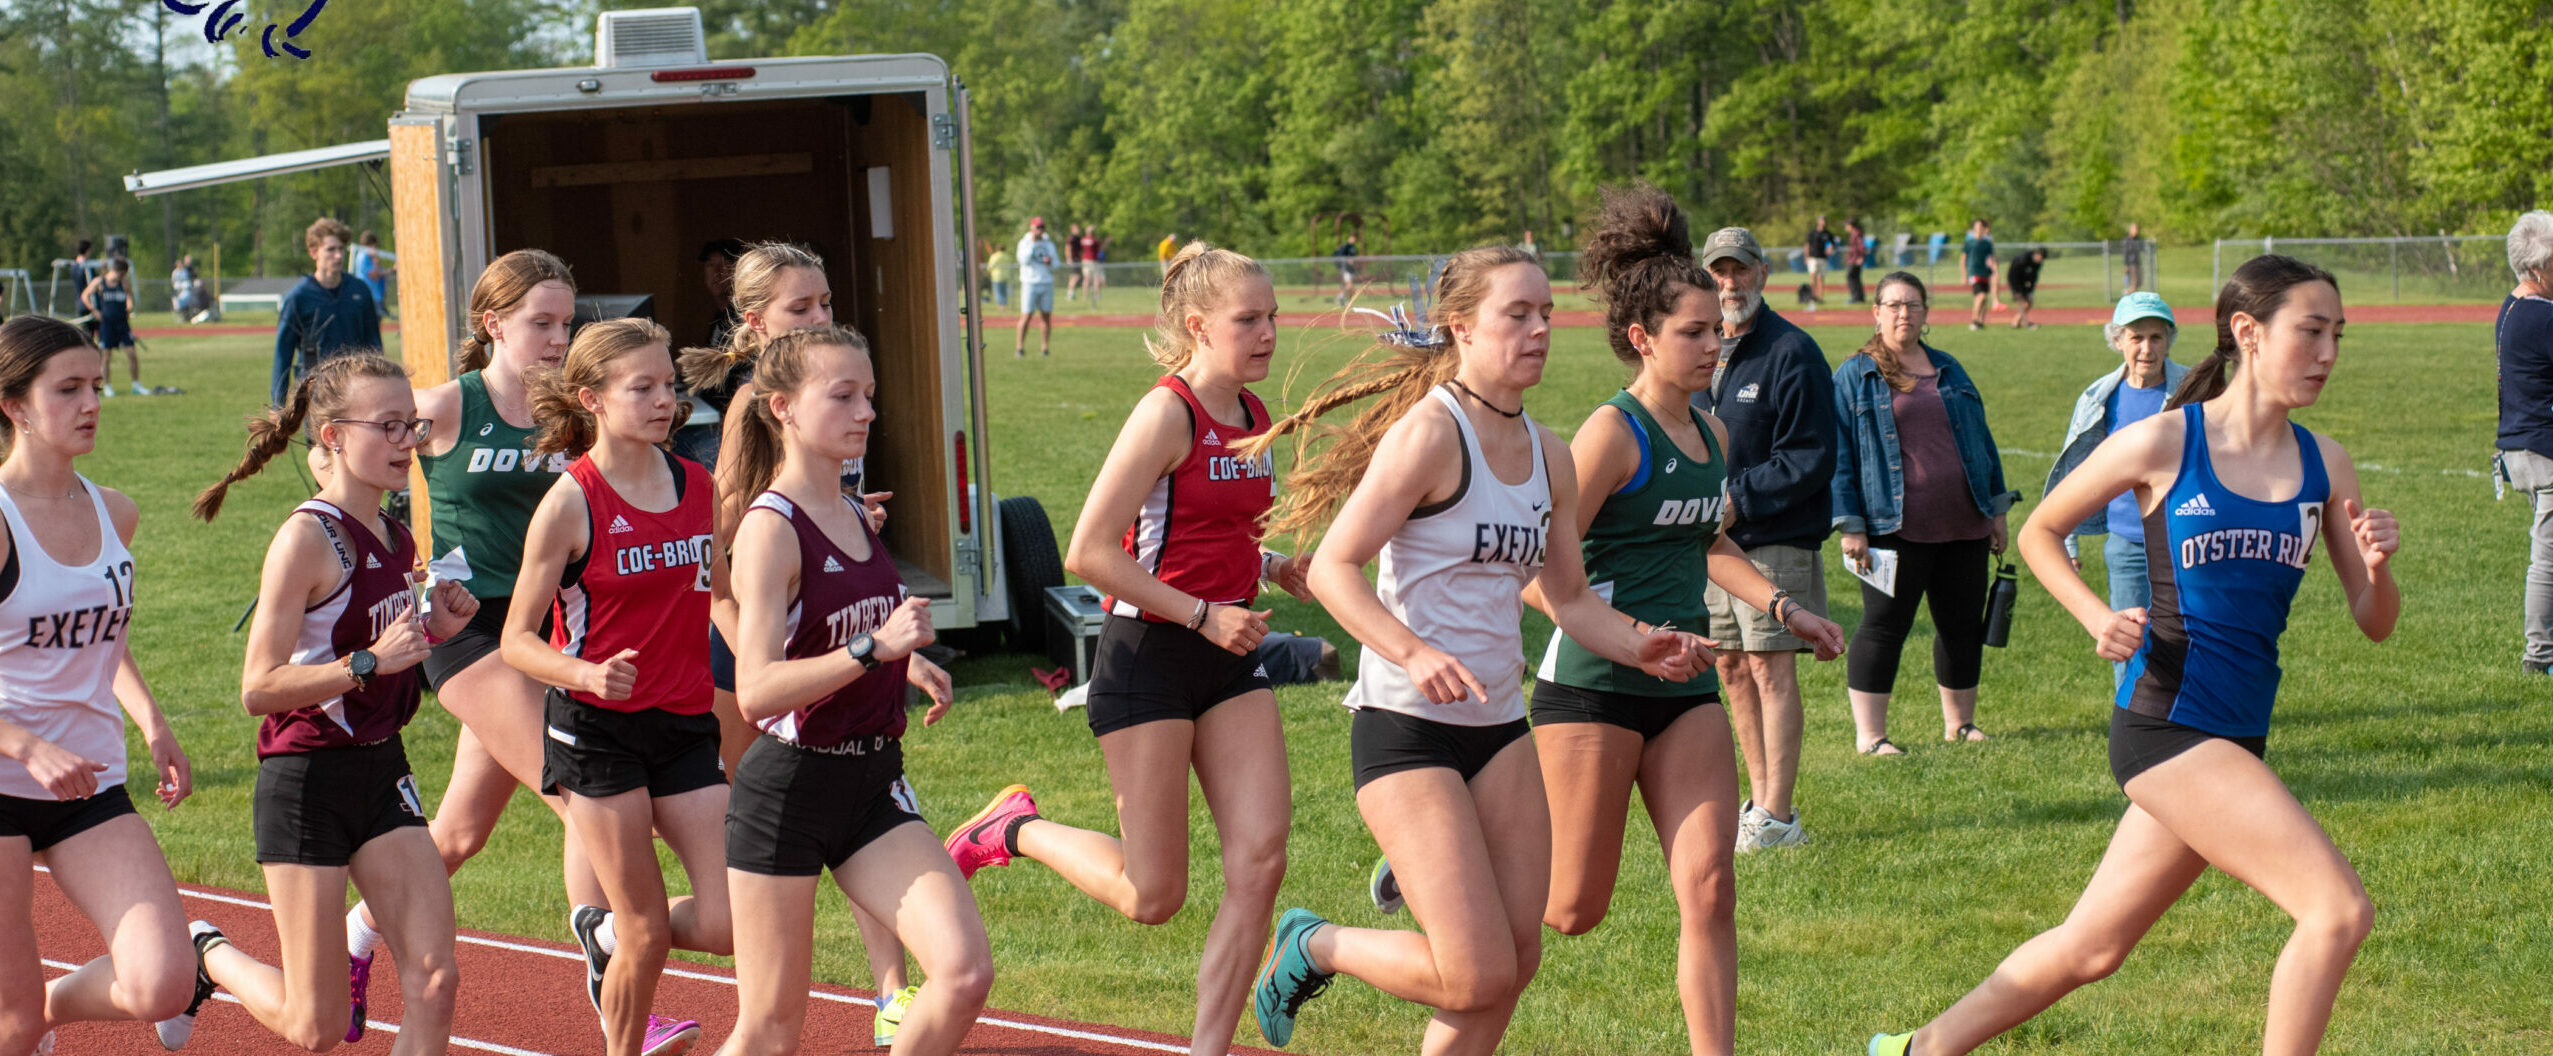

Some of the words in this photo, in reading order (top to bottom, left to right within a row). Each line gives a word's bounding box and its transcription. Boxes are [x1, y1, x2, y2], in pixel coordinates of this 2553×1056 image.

[608, 525, 634, 534] adidas
[2175, 505, 2216, 516] adidas
[2181, 528, 2273, 570] OYSTER
[2302, 506, 2320, 564] 2
[617, 537, 701, 575] COE-BRO
